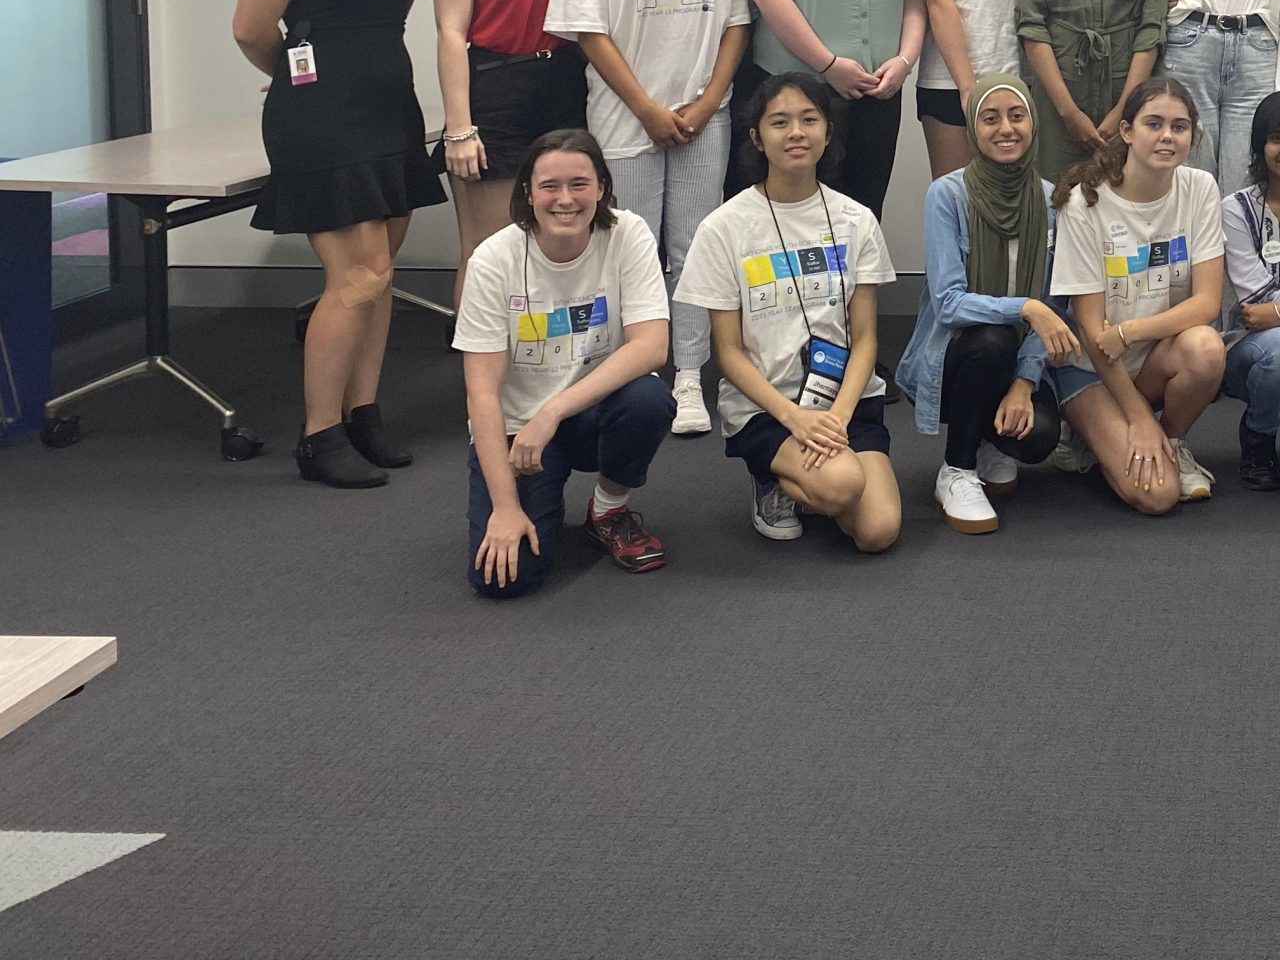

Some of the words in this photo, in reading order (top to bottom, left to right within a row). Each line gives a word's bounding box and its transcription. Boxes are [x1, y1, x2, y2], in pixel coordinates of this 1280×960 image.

[1154, 247, 1161, 255] S
[808, 252, 816, 260] S
[760, 293, 766, 301] 2
[787, 287, 793, 295] 0
[814, 282, 820, 290] 2
[579, 310, 586, 318] S
[555, 345, 561, 353] 0
[595, 335, 600, 343] 1
